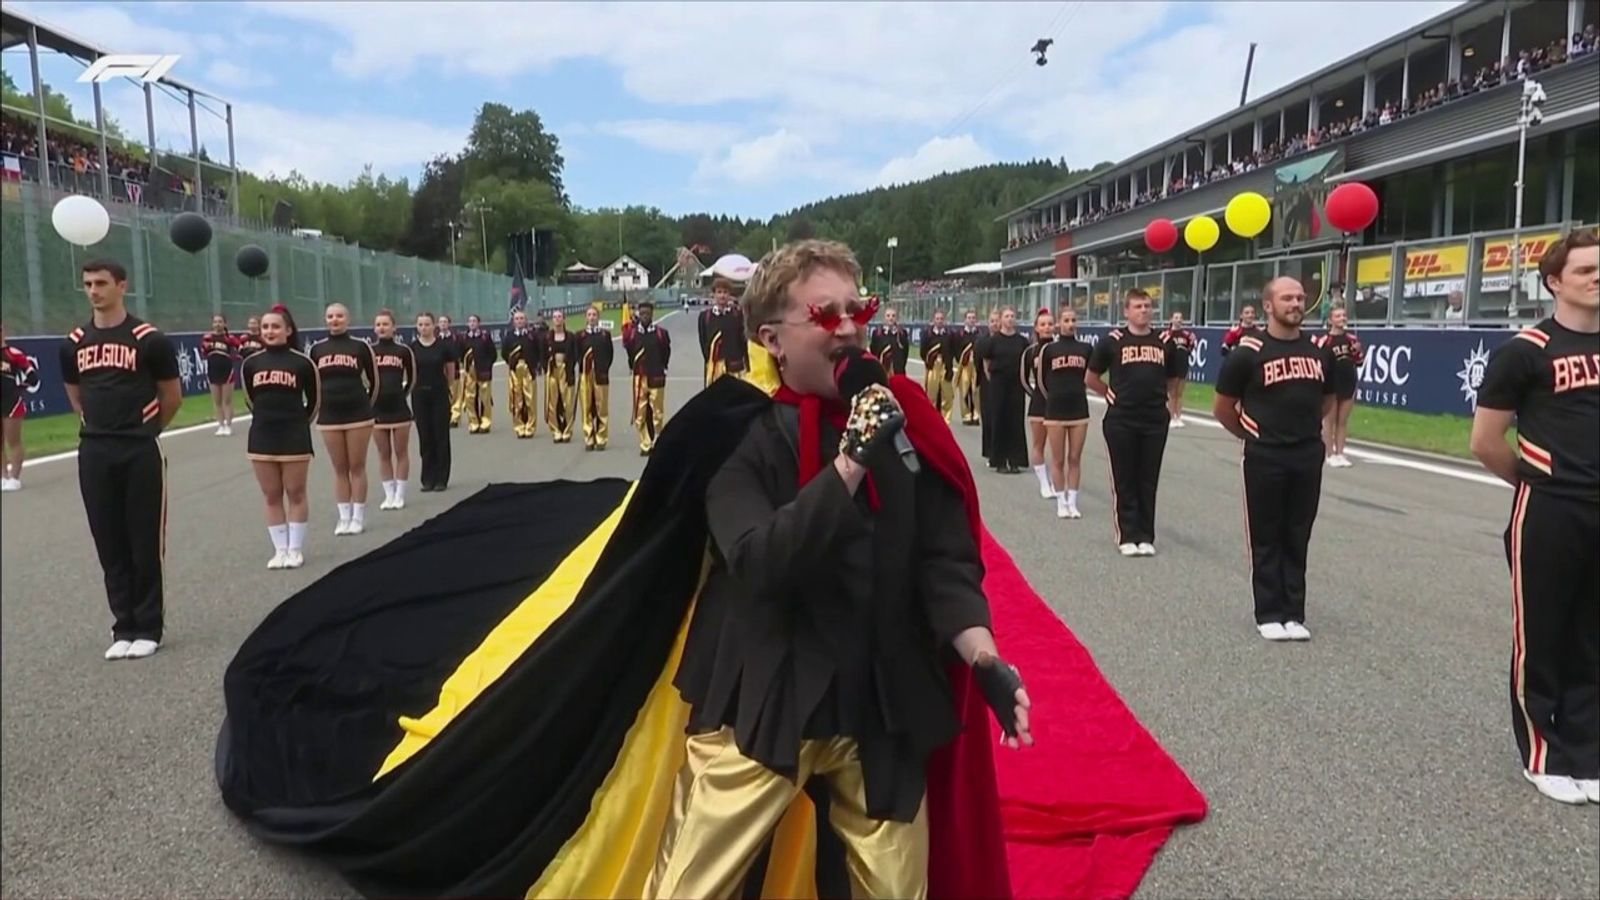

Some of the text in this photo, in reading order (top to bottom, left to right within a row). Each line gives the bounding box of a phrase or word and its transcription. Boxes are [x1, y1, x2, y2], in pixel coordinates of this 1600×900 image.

[77, 343, 137, 373] BELGIUM
[318, 354, 358, 369] BELGIUM
[1122, 345, 1165, 365] BELGIUM
[253, 370, 297, 388] BELGIUM
[1263, 356, 1325, 386] BELGIUM
[1356, 389, 1408, 405] RUISES
